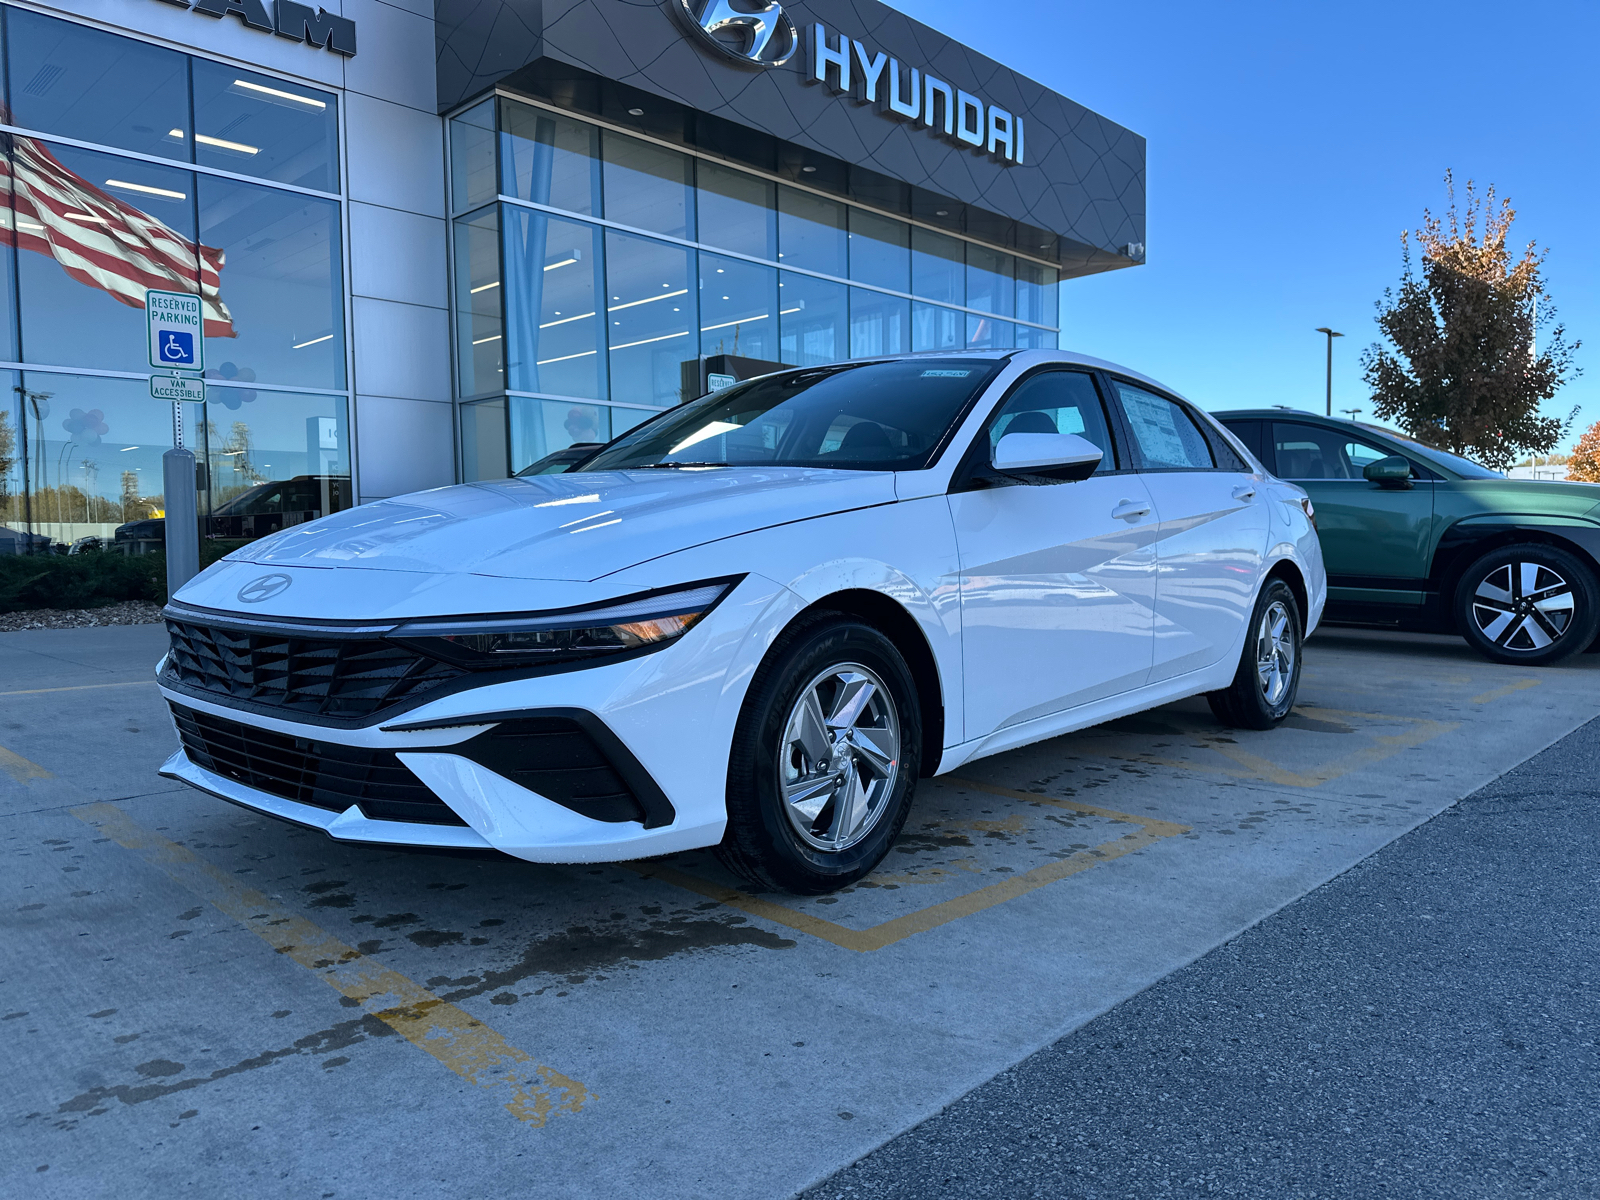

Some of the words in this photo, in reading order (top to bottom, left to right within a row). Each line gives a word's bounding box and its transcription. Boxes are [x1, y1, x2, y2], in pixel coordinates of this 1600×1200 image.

[153, 0, 357, 58] AM
[806, 22, 1024, 165] HYUNDAI
[151, 297, 197, 312] RESERVED
[151, 310, 198, 326] PARKING
[170, 379, 186, 388] VAN
[154, 387, 202, 399] ACCESSIBLE
